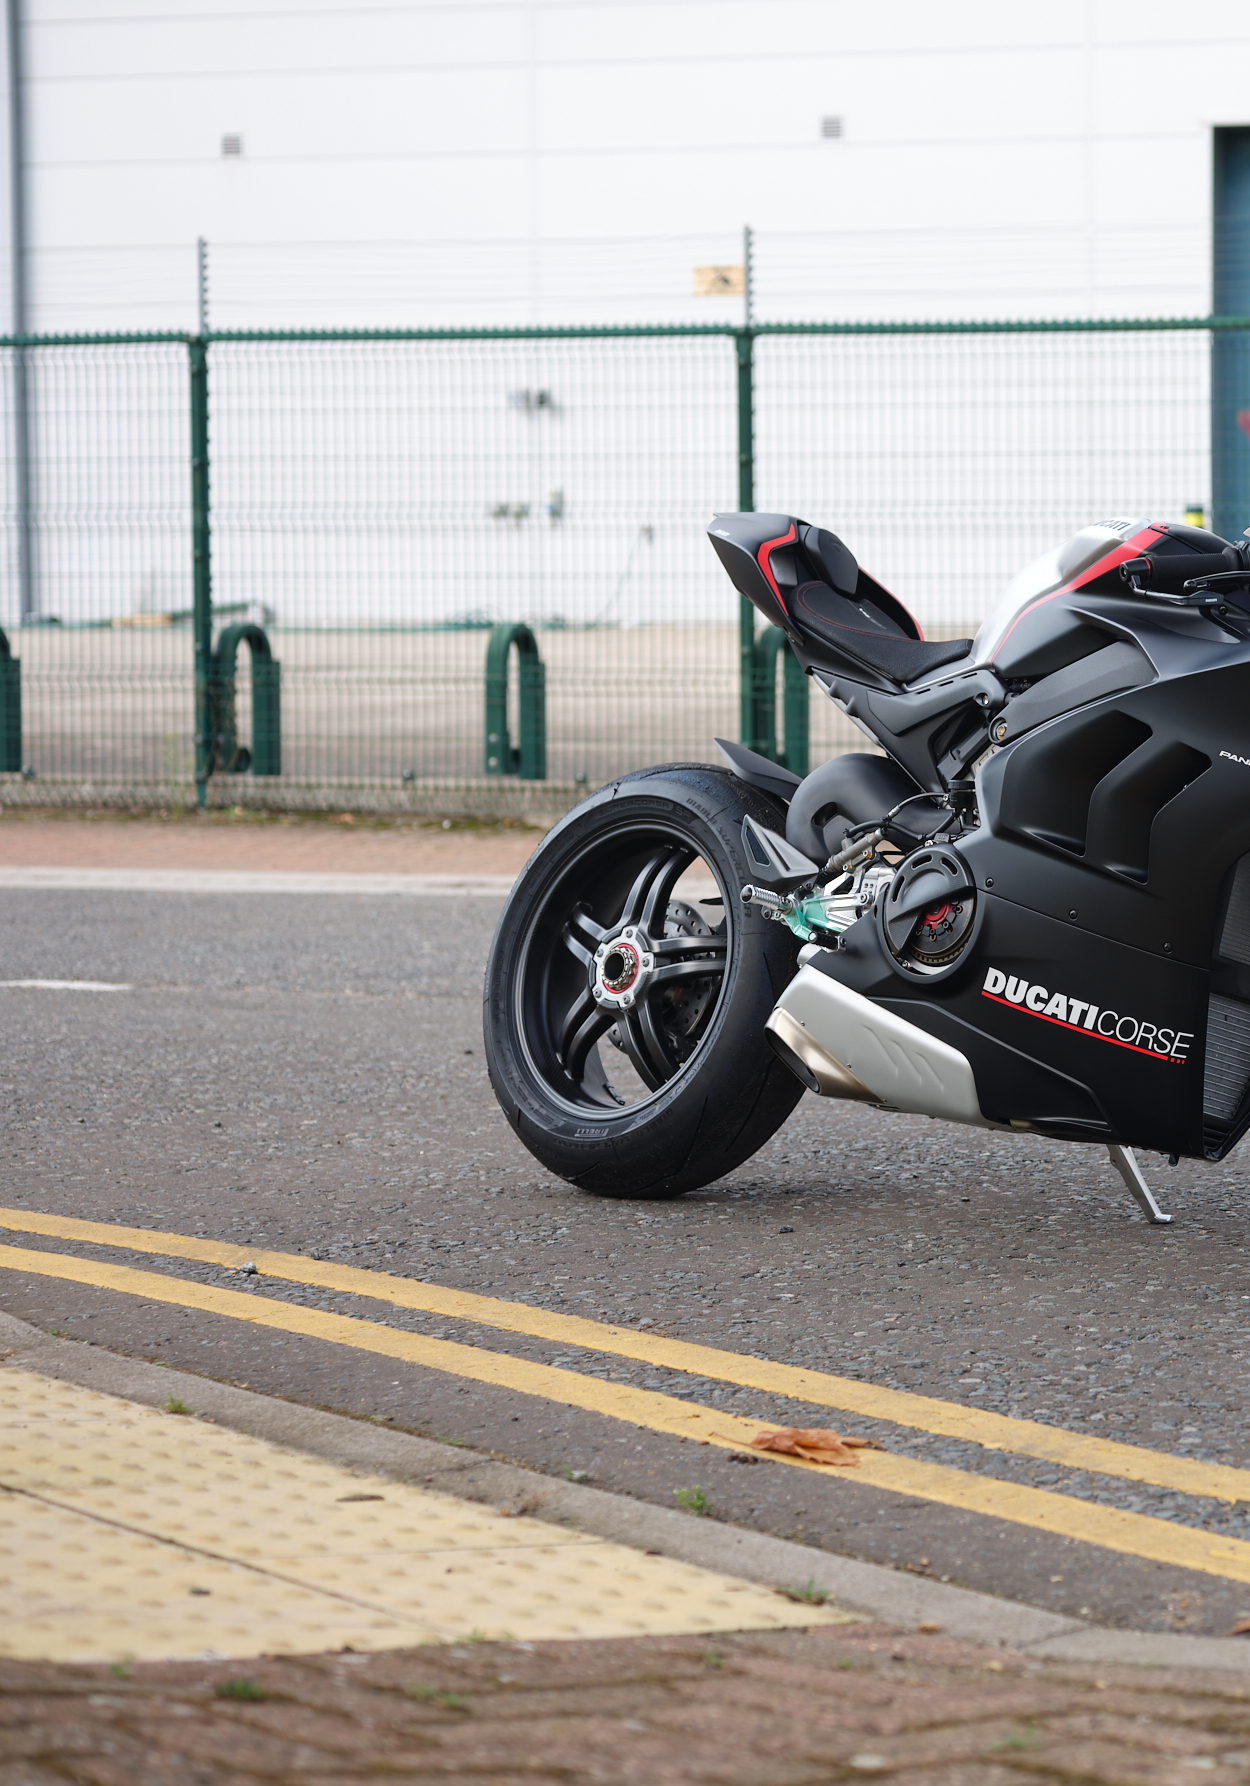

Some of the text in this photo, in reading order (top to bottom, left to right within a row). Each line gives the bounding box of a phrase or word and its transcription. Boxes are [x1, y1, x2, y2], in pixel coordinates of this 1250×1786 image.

[982, 966, 1194, 1059] DUCATI CORSE
[574, 1128, 609, 1137] PIRELLI
